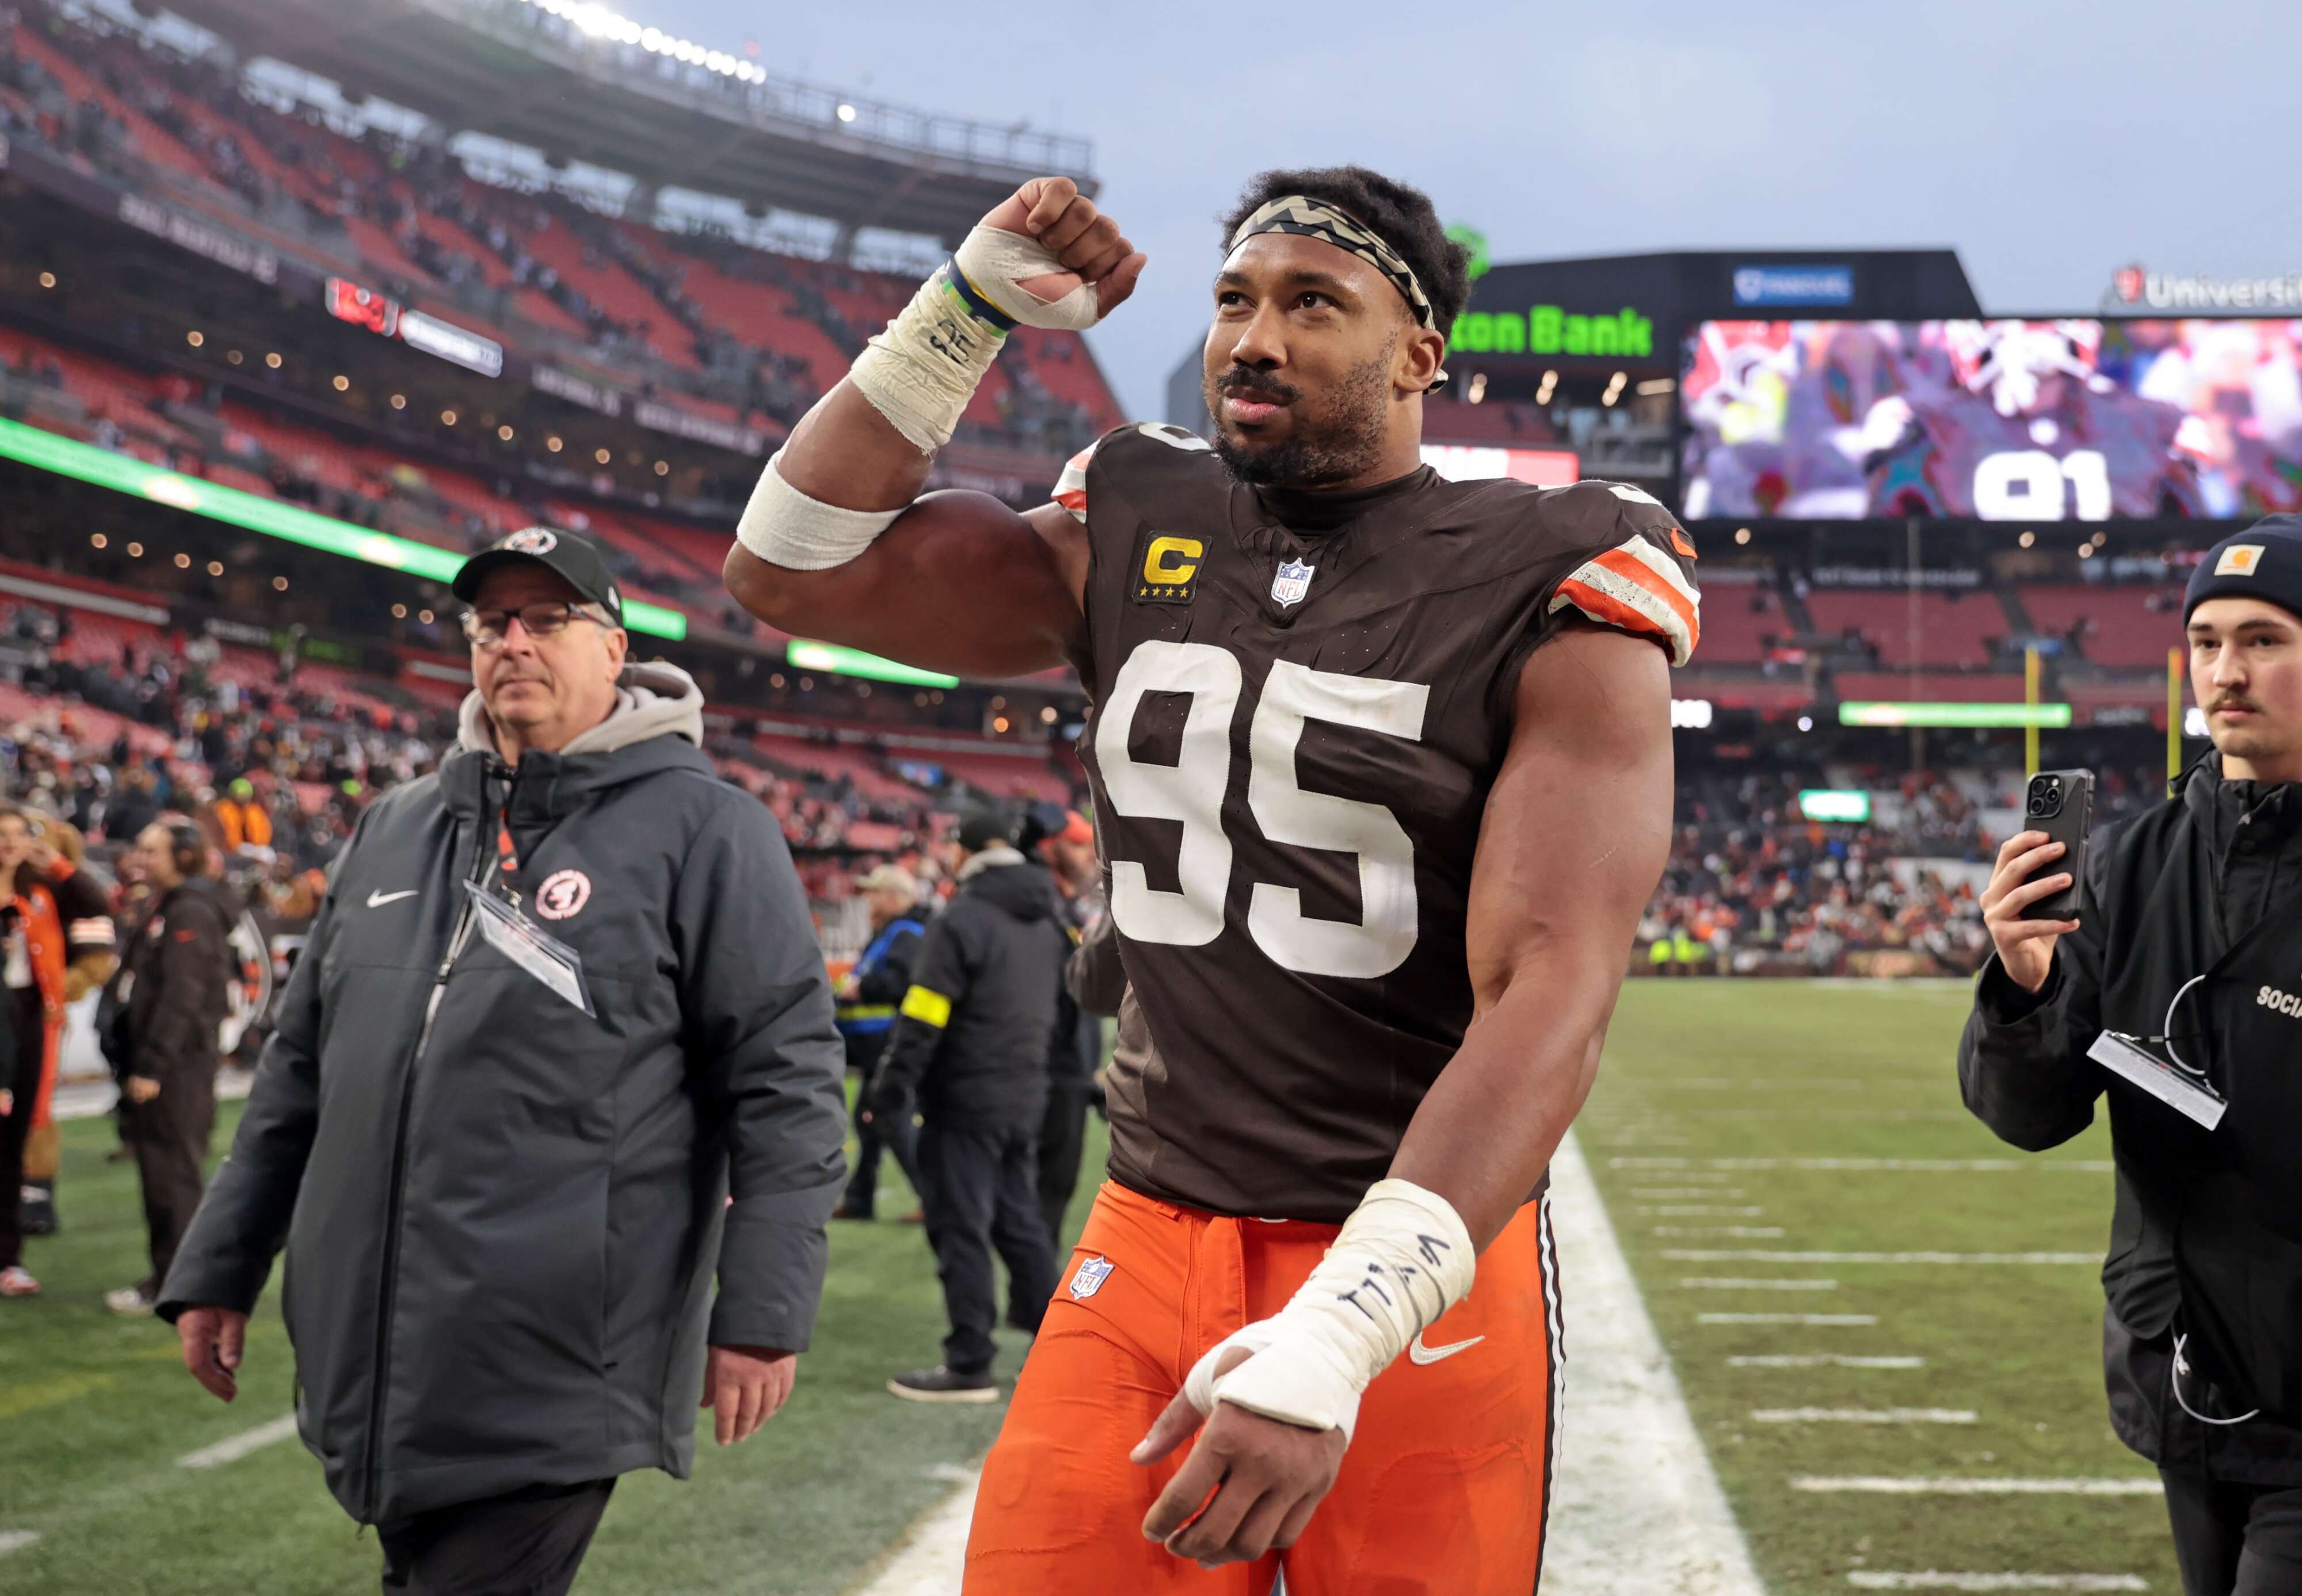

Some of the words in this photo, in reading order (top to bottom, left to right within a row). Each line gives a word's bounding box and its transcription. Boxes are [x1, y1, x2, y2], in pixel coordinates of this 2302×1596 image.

[2145, 272, 2302, 308] Universi
[1530, 305, 1652, 357] Bank
[1144, 536, 1203, 585] C
[1277, 580, 1301, 598] NFL
[1095, 640, 1431, 979] 95
